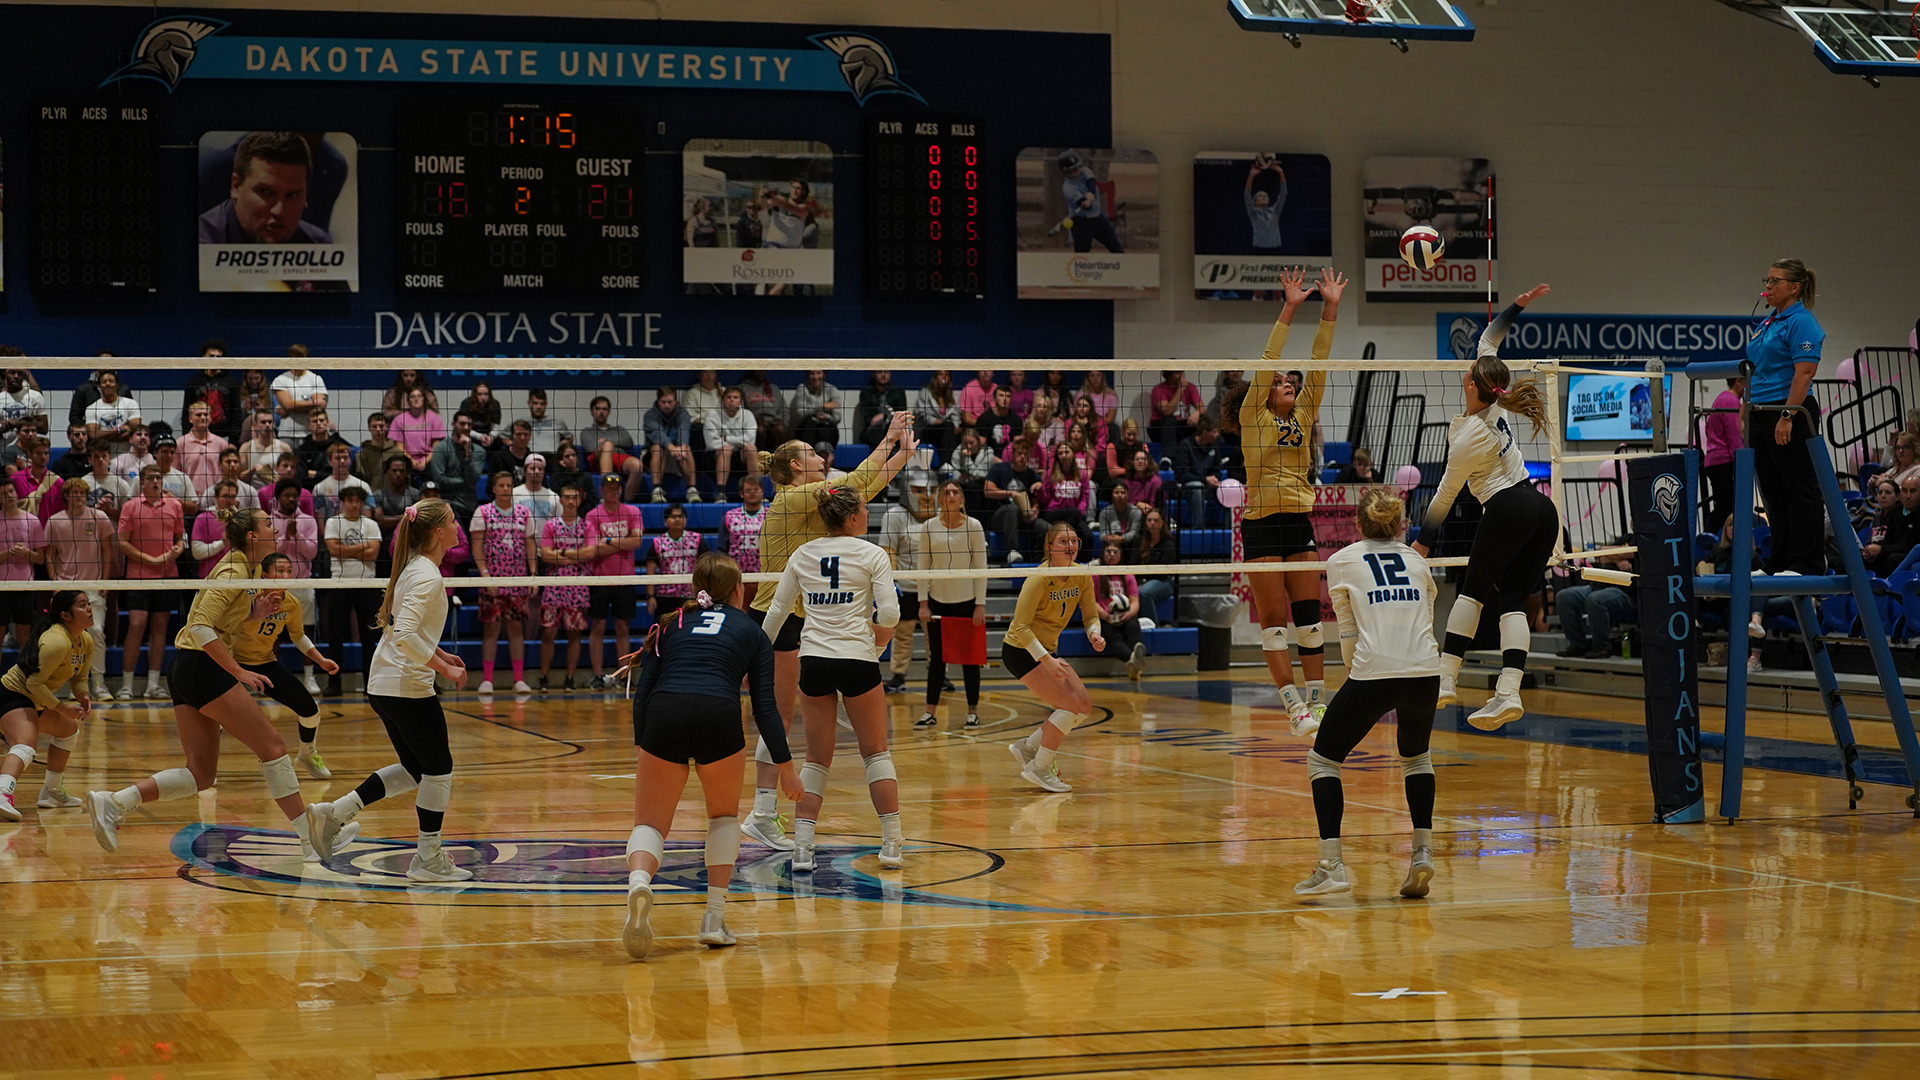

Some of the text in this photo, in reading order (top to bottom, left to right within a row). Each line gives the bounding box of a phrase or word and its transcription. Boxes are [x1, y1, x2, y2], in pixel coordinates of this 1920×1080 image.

[246, 44, 792, 82] DAKOTA STATE UNIVERSITY
[41, 107, 148, 121] PLYR ACES KILLS
[509, 112, 577, 149] 1:15
[878, 121, 976, 137] PLYR ACES KILLS
[928, 144, 977, 167] 0 0
[414, 155, 466, 175] HOME
[501, 166, 544, 180] PERIOD
[575, 157, 632, 177] GUEST
[928, 169, 978, 191] 0 0
[514, 186, 531, 215] 2
[588, 184, 633, 220] 21
[928, 195, 978, 217] 0 3
[405, 222, 444, 236] FOULS
[484, 223, 567, 238] PLAYER FOUL
[601, 225, 640, 239] FOULS
[929, 220, 978, 241] 0 5
[1369, 229, 1398, 238] DAKOTA
[215, 250, 345, 267] PROSTROLLO
[966, 247, 978, 267] 0
[1074, 259, 1120, 270] Heartland
[732, 264, 796, 280] ROSEBUD
[1074, 269, 1104, 280] Energy
[1240, 264, 1259, 272] First
[404, 274, 445, 288] SCORE
[503, 274, 544, 288] MATCH
[601, 275, 640, 289] SCORE
[375, 311, 664, 349] DAKOTA STATE
[1505, 321, 1591, 351] ROJAN
[1577, 391, 1615, 404] TAG US ON
[1571, 401, 1623, 415] SOCIAL MEDIA
[1277, 425, 1304, 447] 23
[1308, 509, 1357, 519] UPPORTING
[820, 556, 840, 589] 4
[1362, 552, 1411, 587] 12
[808, 591, 854, 605] TROJANS
[1049, 587, 1079, 601] BELLEVUE
[1367, 588, 1420, 605] TROJANS
[1060, 601, 1066, 618] 1
[257, 621, 277, 636] 13
[690, 611, 727, 636] 3
[1663, 537, 1700, 793] TROJANS
